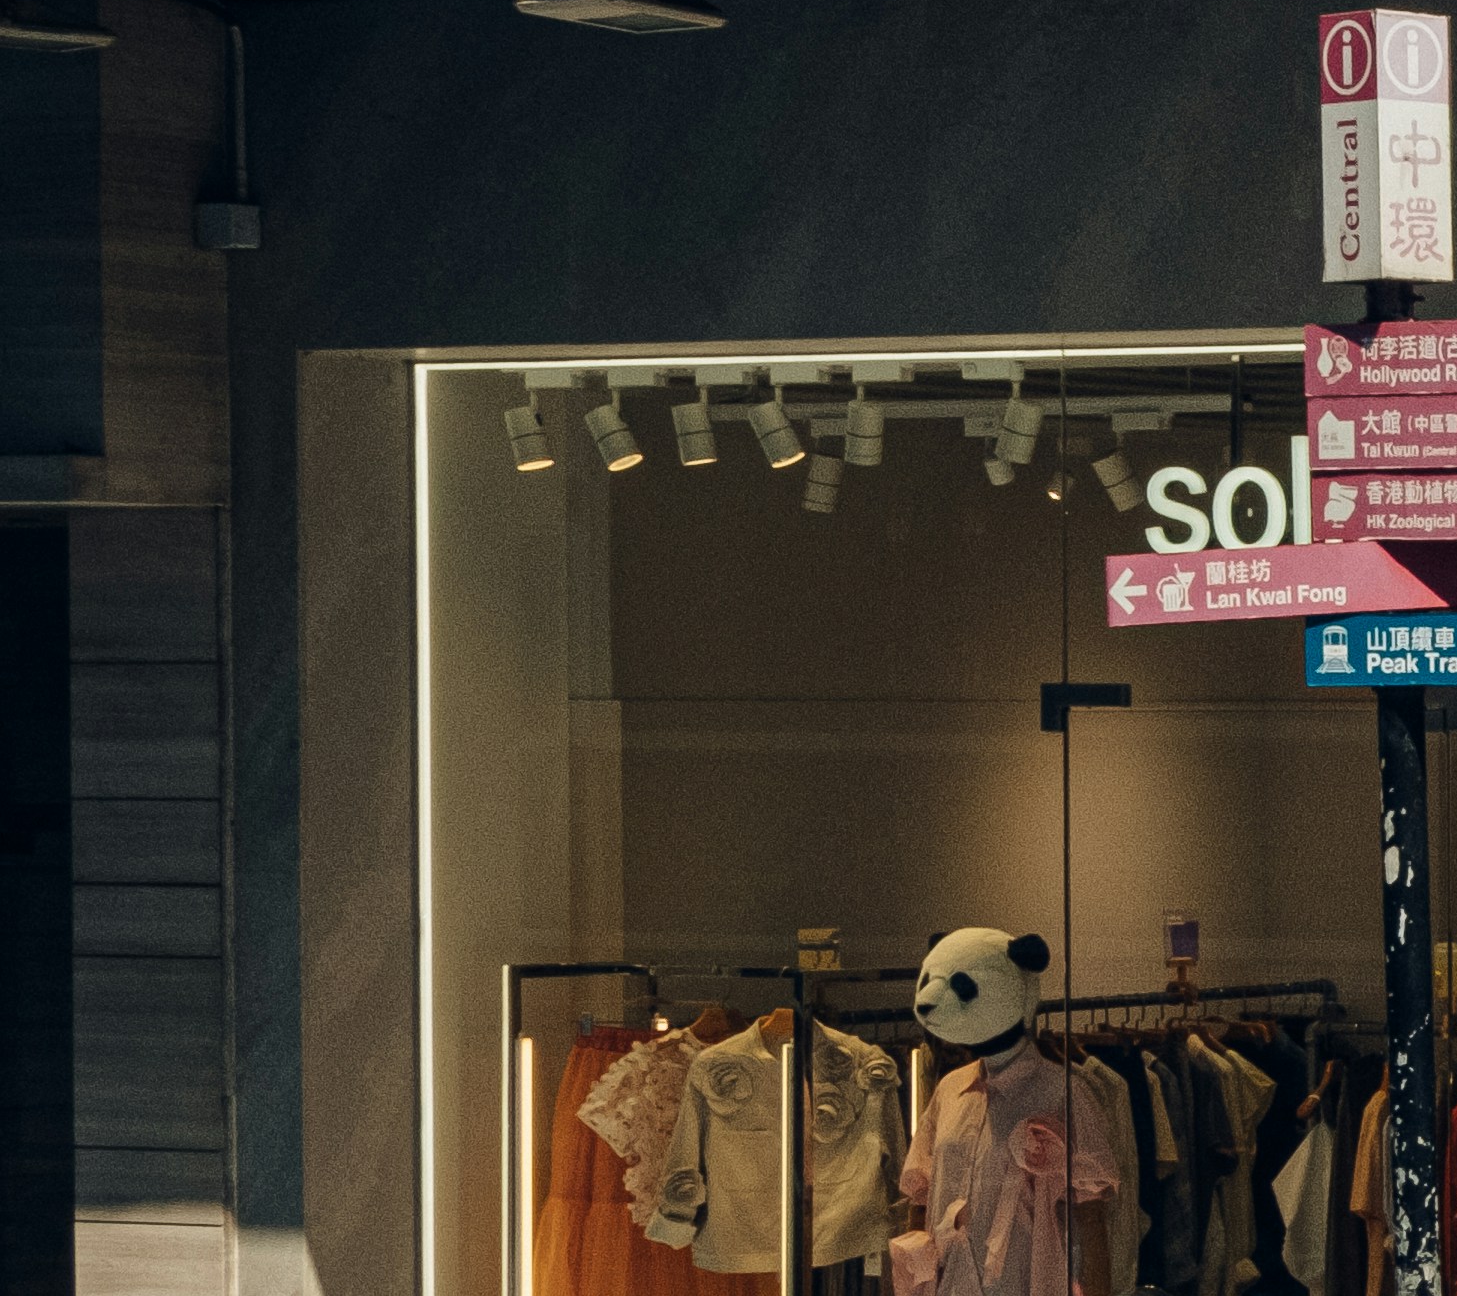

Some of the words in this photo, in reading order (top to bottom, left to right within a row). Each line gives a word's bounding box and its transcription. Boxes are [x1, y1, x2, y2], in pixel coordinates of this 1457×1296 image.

[1336, 117, 1361, 262] Central
[1388, 119, 1445, 263] 中環
[1360, 365, 1441, 387] Hollywood
[1361, 409, 1402, 436] 大館
[1361, 443, 1381, 457] Tai
[1384, 442, 1420, 457] Kwun
[1422, 445, 1456, 458] (Central
[1366, 514, 1386, 528] HK
[1389, 513, 1457, 532] Zoological
[1205, 558, 1271, 586] 蘭桂坊
[1206, 590, 1241, 609] Lan
[1246, 586, 1292, 607] Kwai
[1297, 584, 1347, 607] Fong
[1366, 626, 1456, 652] 山頂纜車
[1366, 652, 1419, 674] Peak
